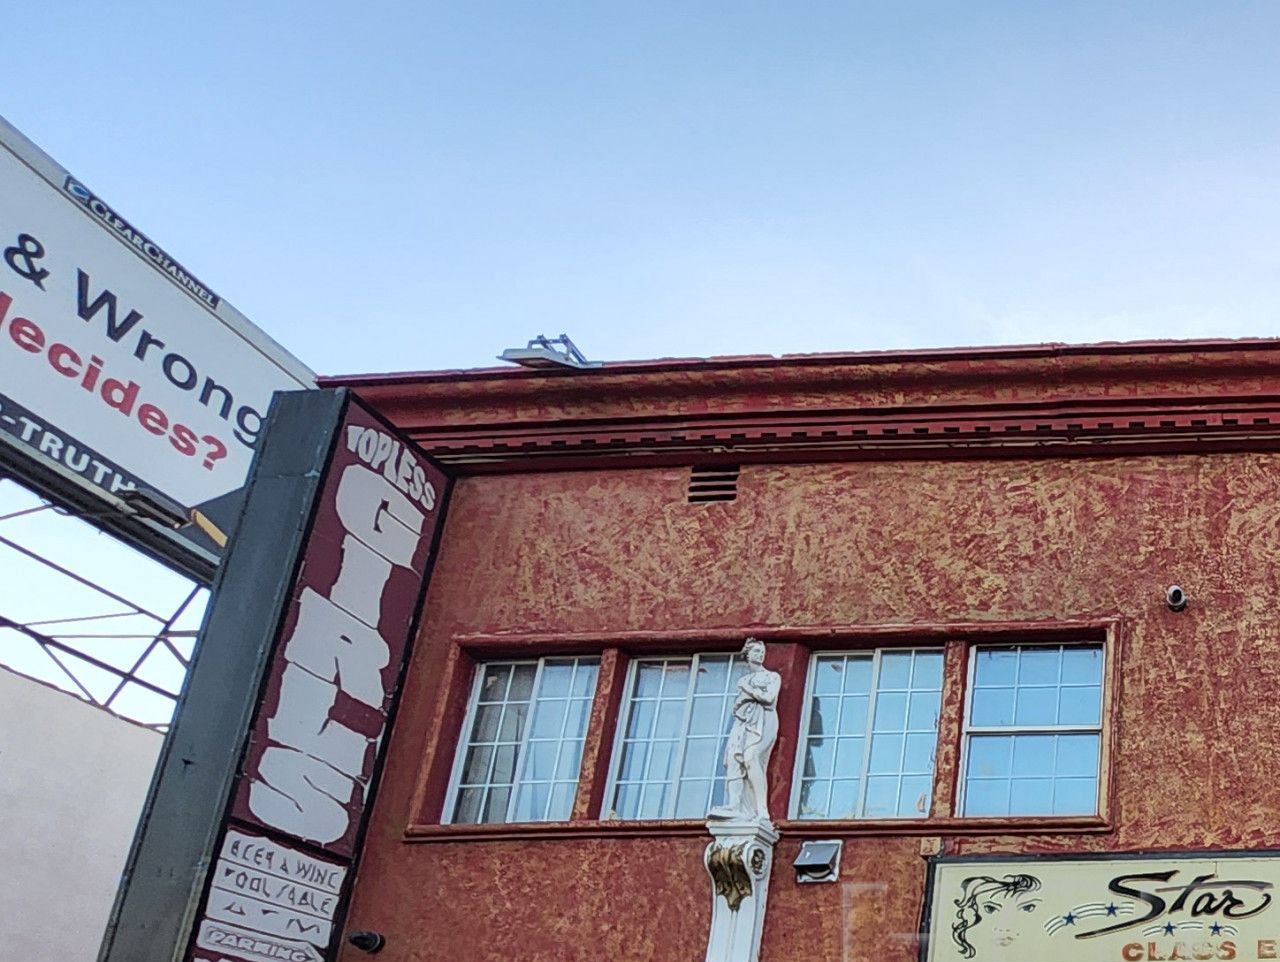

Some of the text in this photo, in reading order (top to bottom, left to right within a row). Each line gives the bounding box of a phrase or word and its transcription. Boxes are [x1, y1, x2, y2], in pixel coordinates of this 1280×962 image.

[3, 233, 268, 450] & Wrong
[346, 425, 436, 511] TOPLESS
[249, 463, 426, 847] GIRLS
[1075, 870, 1273, 939] Star
